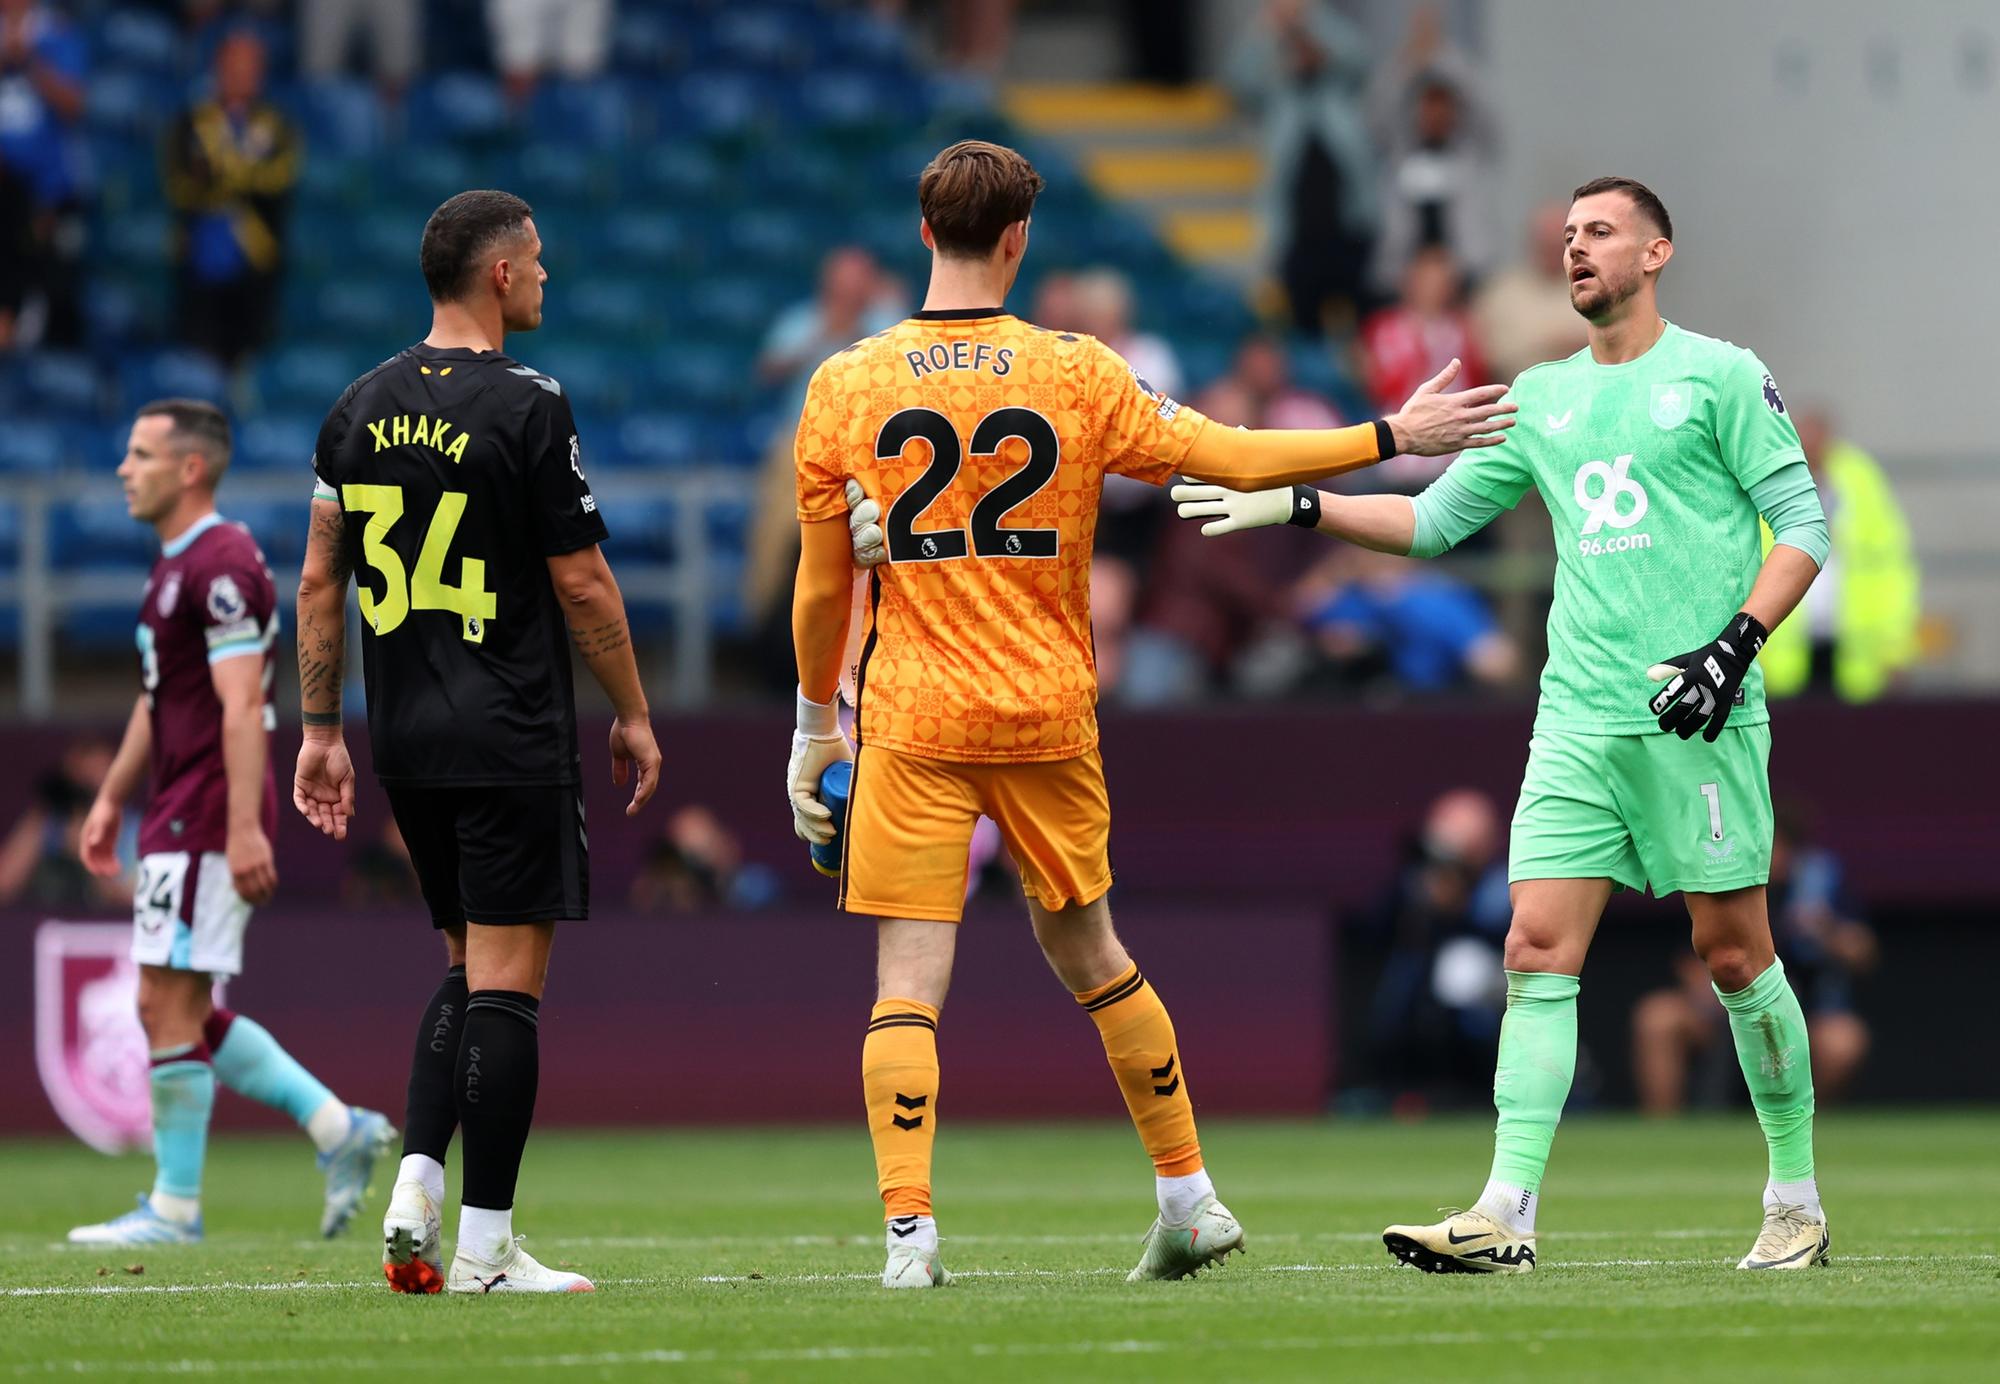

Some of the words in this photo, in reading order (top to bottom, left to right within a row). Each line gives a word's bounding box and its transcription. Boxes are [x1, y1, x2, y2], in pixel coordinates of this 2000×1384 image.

[906, 341, 1013, 378] ROEFS
[367, 415, 470, 464] XHAKA
[875, 406, 1060, 563] 22
[1574, 454, 1648, 536] 96
[341, 484, 497, 644] 34
[1579, 533, 1652, 557] 96.com
[1699, 782, 1724, 842] 1
[430, 1003, 454, 1052] SAFC
[466, 1046, 481, 1103] SAFC
